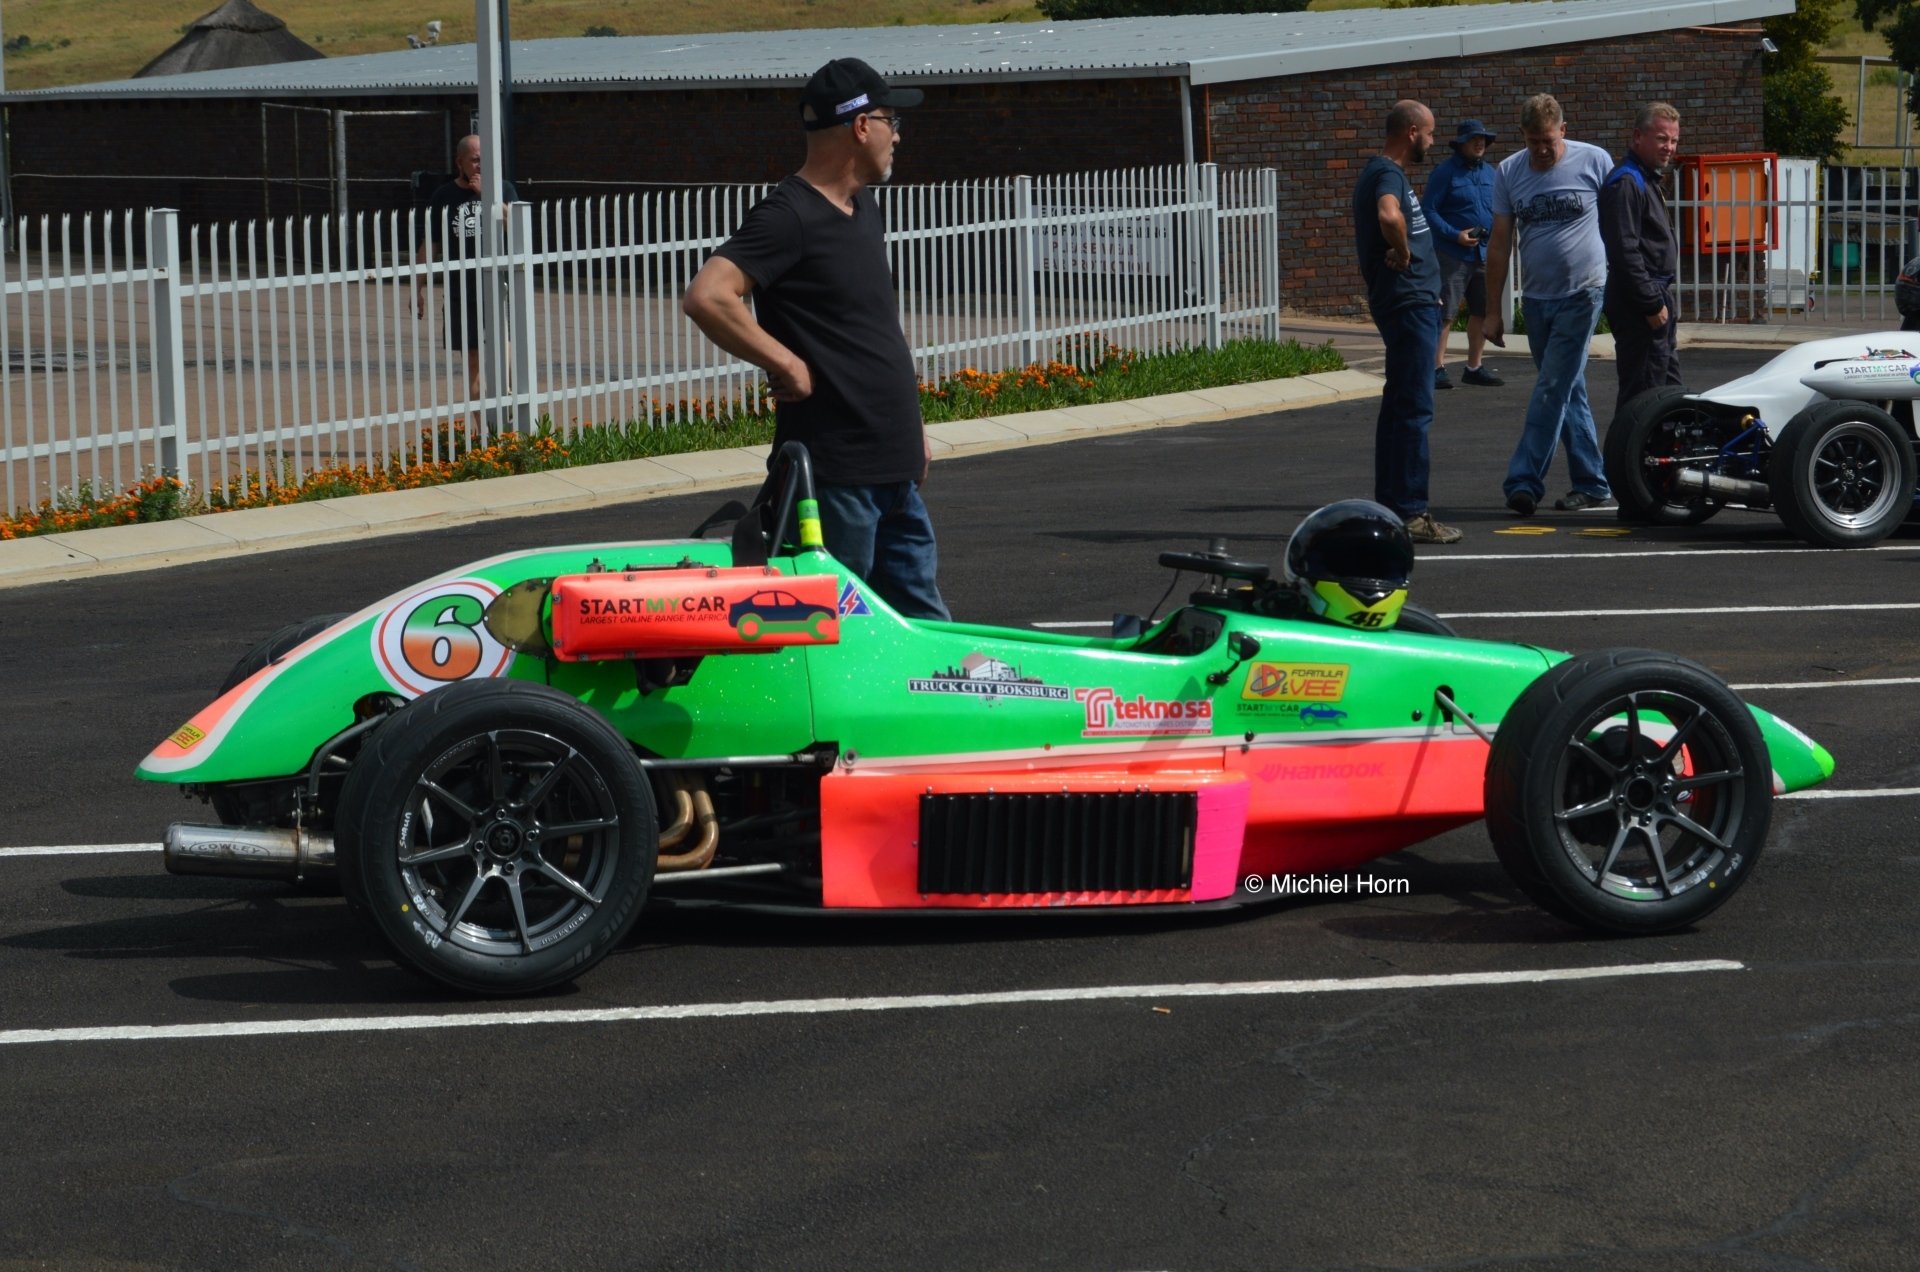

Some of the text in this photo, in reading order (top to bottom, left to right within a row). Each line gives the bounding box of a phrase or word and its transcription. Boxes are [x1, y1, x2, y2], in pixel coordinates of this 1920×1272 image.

[1844, 364, 1909, 375] STARTMYCAR
[580, 596, 726, 615] STARTMYCAR
[580, 613, 728, 625] LARGEST ONLINE RANGE IN AFRICA
[1345, 611, 1387, 627] 46
[400, 593, 486, 682] 6
[1291, 668, 1344, 678] FORMULA
[910, 680, 959, 692] TRUCK
[961, 682, 994, 694] CITY
[996, 684, 1068, 699] BOKSBURG
[1290, 678, 1341, 697] VEE
[1114, 695, 1212, 719] teknosa
[198, 843, 261, 854] COWLEY
